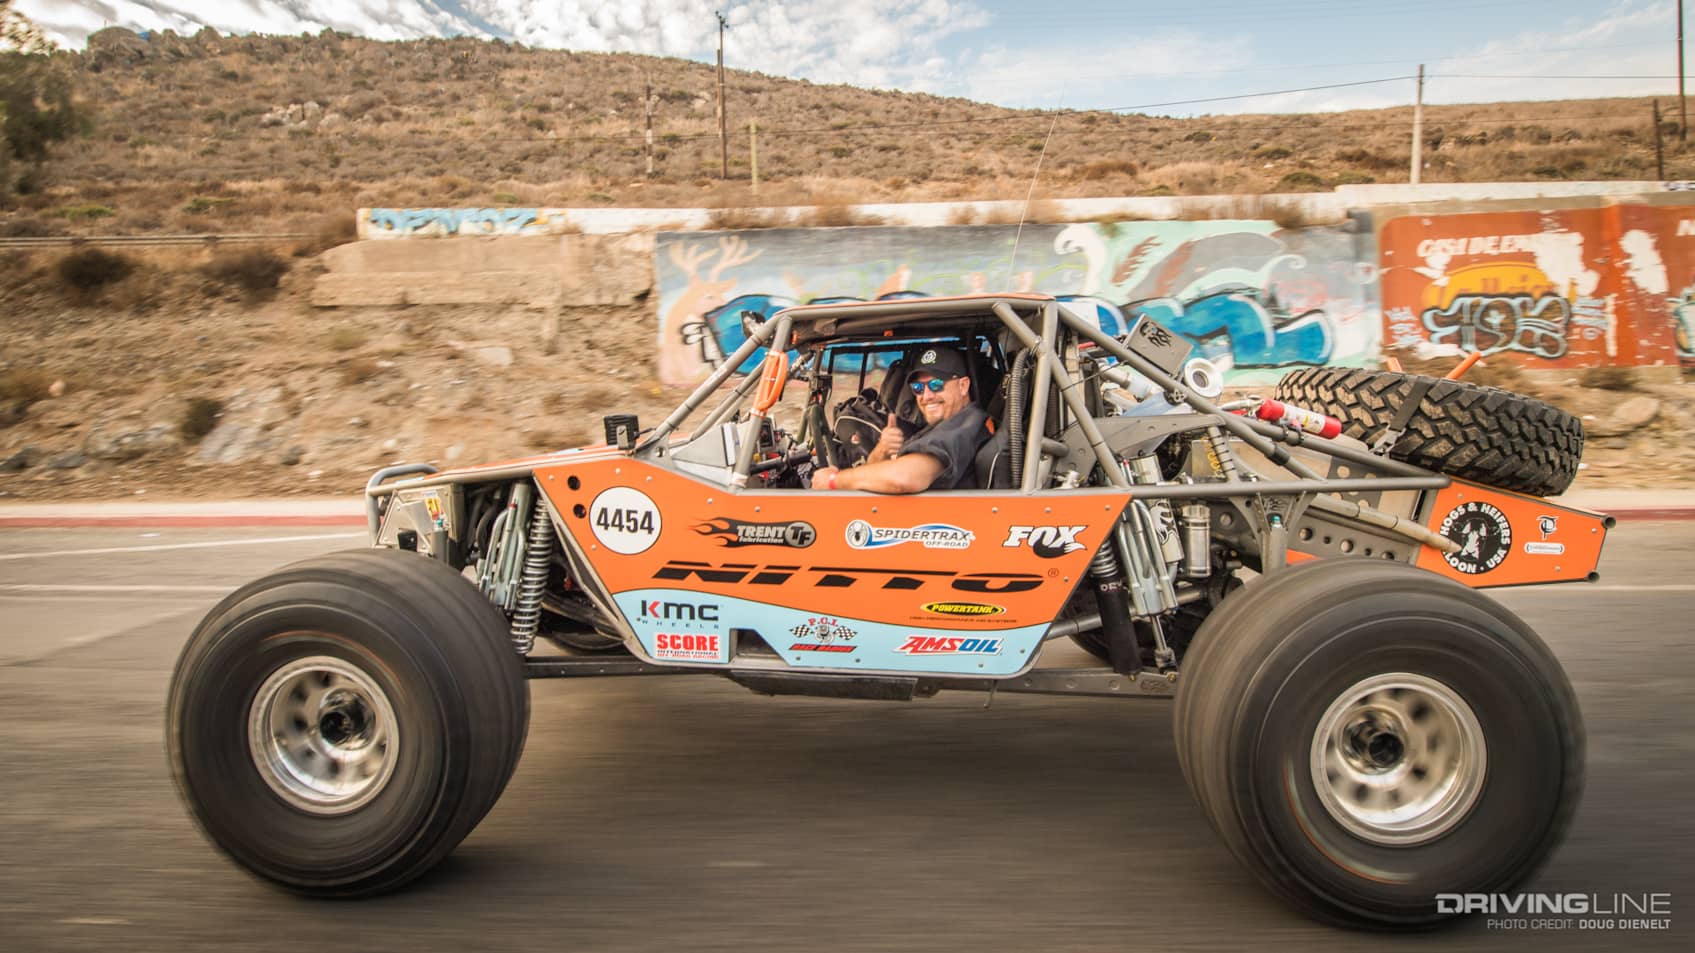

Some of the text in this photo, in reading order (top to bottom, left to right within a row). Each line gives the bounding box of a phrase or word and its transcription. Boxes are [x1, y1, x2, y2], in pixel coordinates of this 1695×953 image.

[596, 507, 655, 535] 4454
[1440, 502, 1511, 545] HOGS & HEIFERS
[736, 525, 786, 538] TRENT
[738, 536, 784, 544] fabrication
[874, 528, 971, 541] SPIDERTRAX
[925, 540, 969, 548] OFF-ROAD
[1002, 524, 1089, 558] FOX
[1442, 550, 1477, 574] LOON
[1486, 547, 1508, 569] USA
[651, 560, 1044, 593] NITTO
[656, 634, 719, 651] SCORE
[900, 636, 1000, 653] AMSOIL
